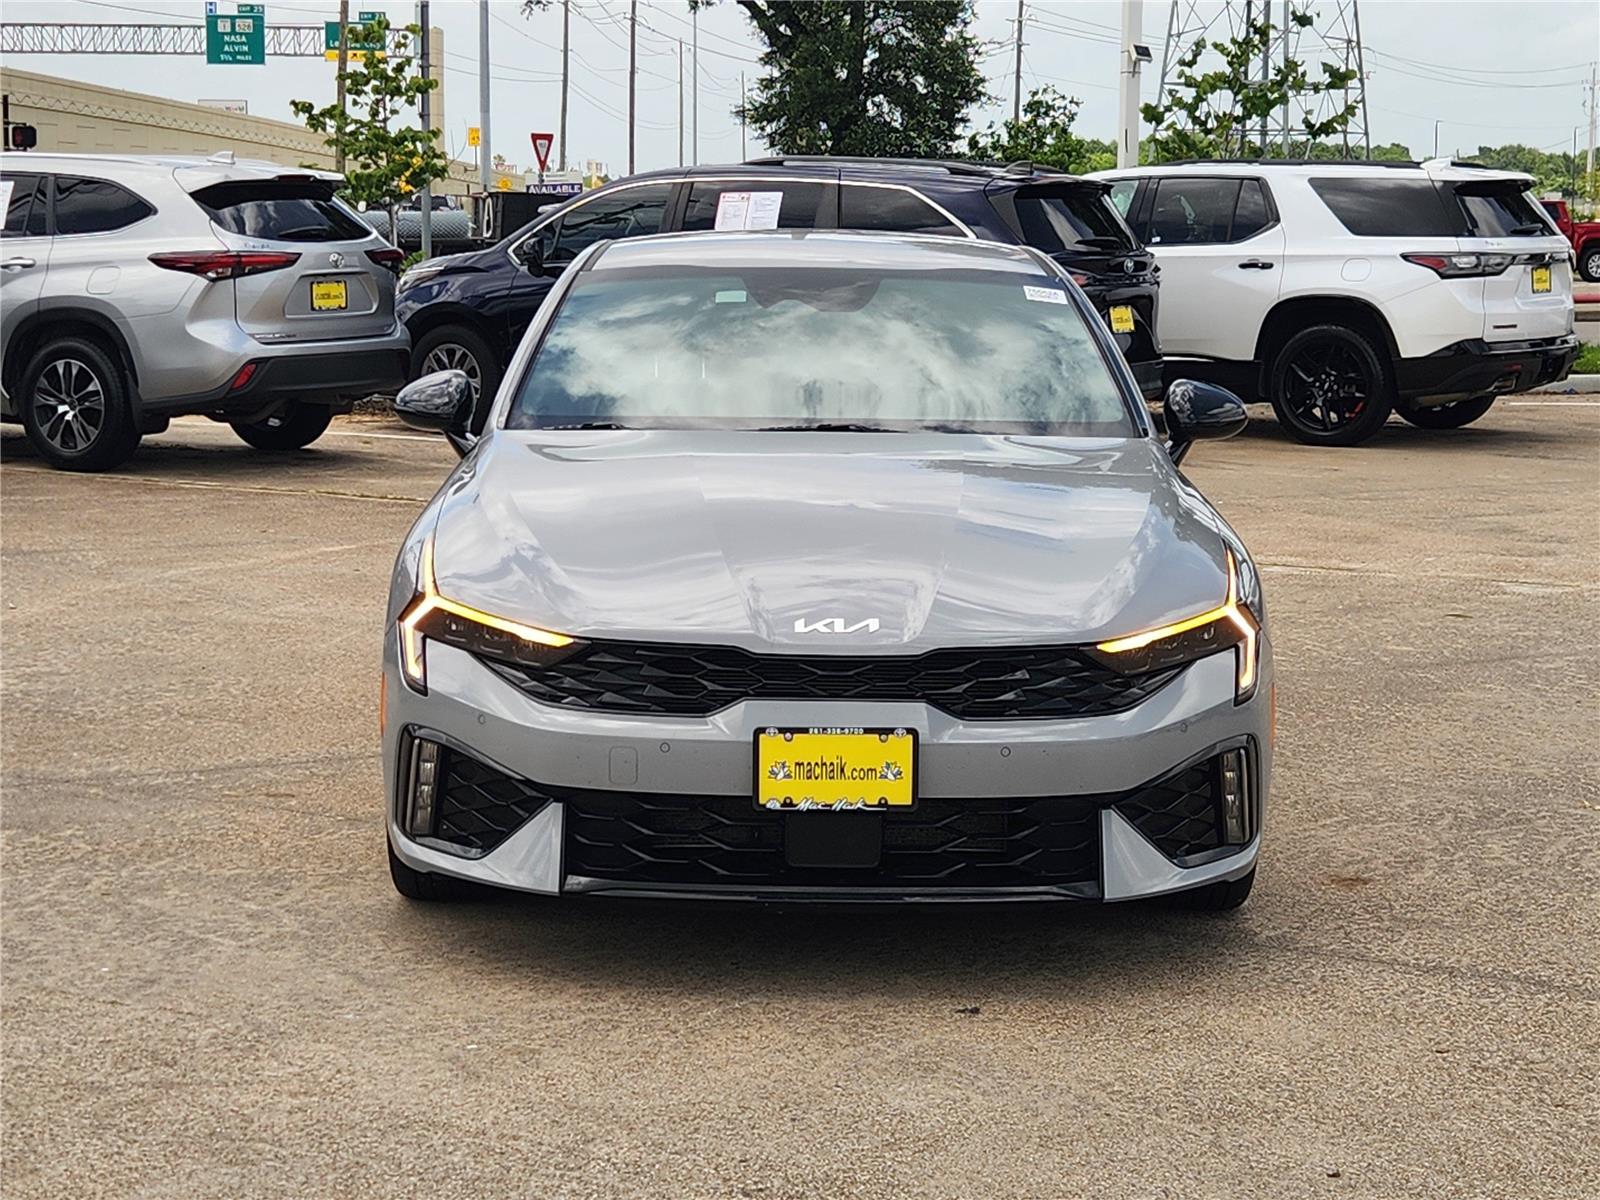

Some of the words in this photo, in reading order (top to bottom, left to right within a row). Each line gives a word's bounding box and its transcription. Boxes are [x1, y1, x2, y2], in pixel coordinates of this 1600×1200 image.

[223, 35, 247, 43] NASA
[223, 44, 249, 52] ALVIN
[528, 184, 581, 195] AVAILABLE
[793, 617, 880, 634] KIA
[793, 755, 878, 782] machaik.com
